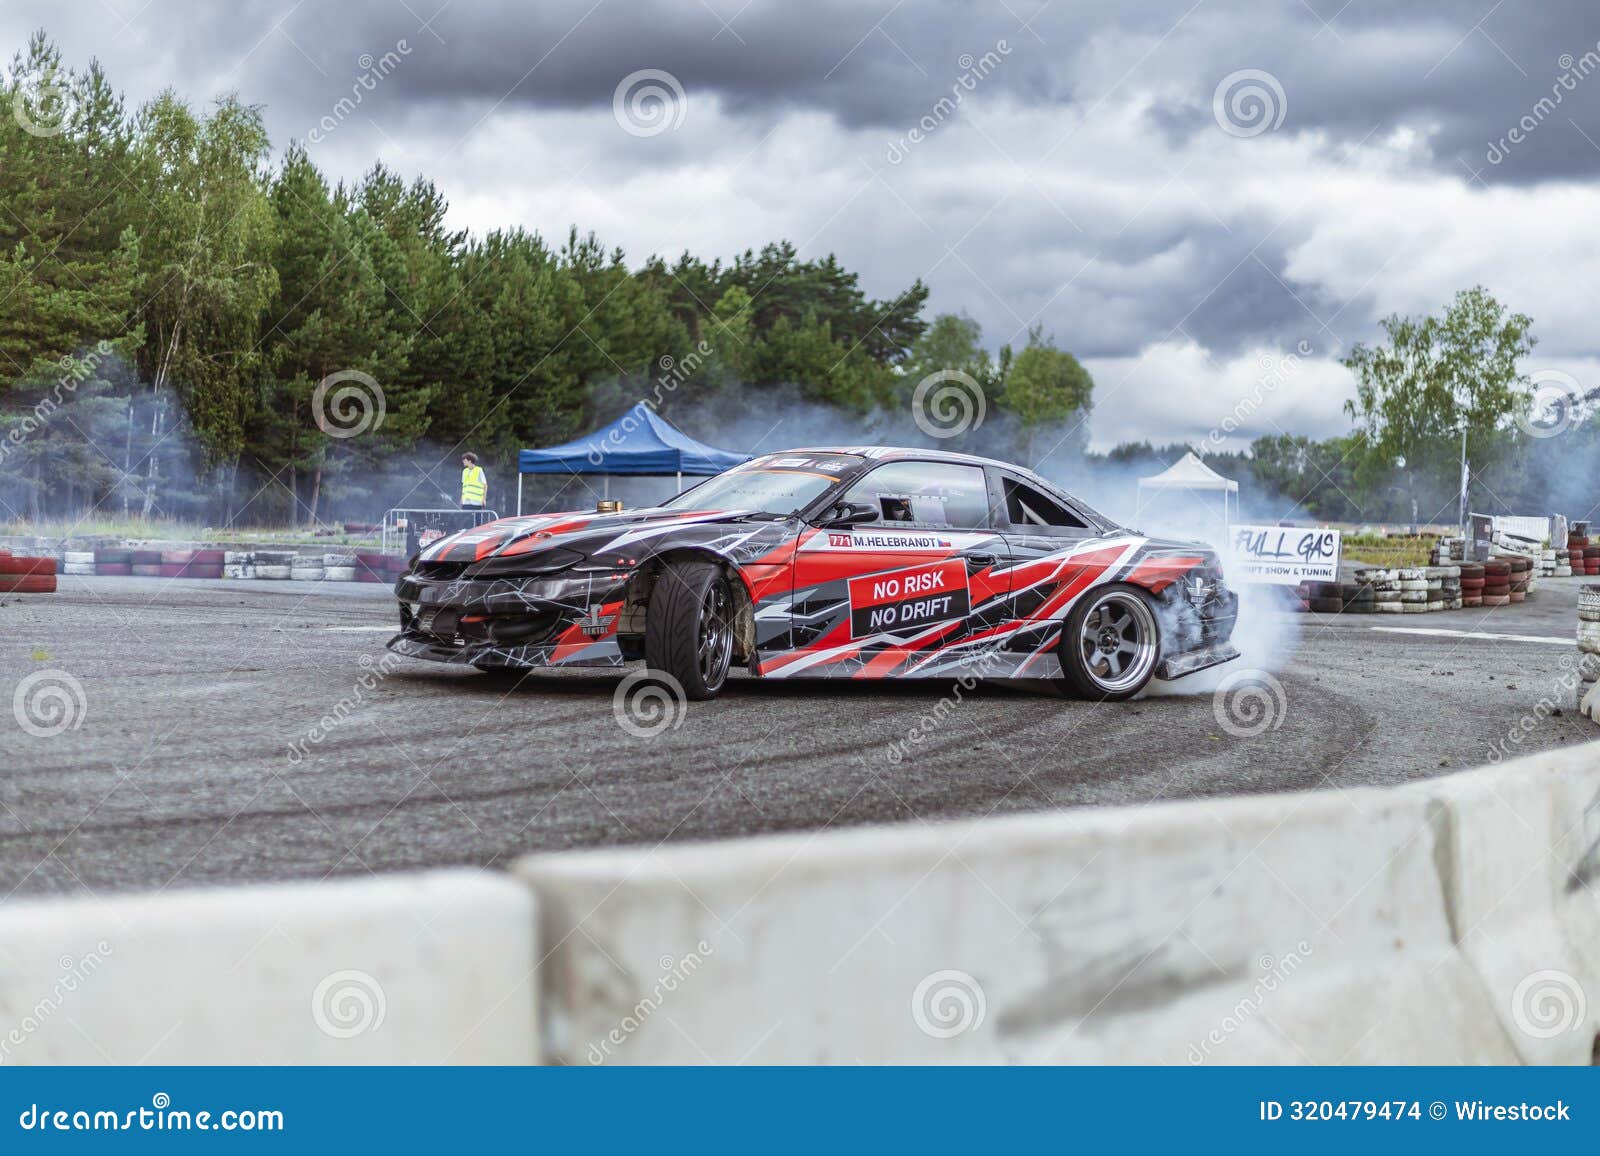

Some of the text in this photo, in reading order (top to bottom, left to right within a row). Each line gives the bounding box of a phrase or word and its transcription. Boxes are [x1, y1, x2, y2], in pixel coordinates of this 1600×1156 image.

[1235, 530, 1334, 563] FULL GAS
[873, 570, 945, 600] NO RISK
[1265, 567, 1290, 575] SHOW
[870, 596, 952, 628] NO DRIFT
